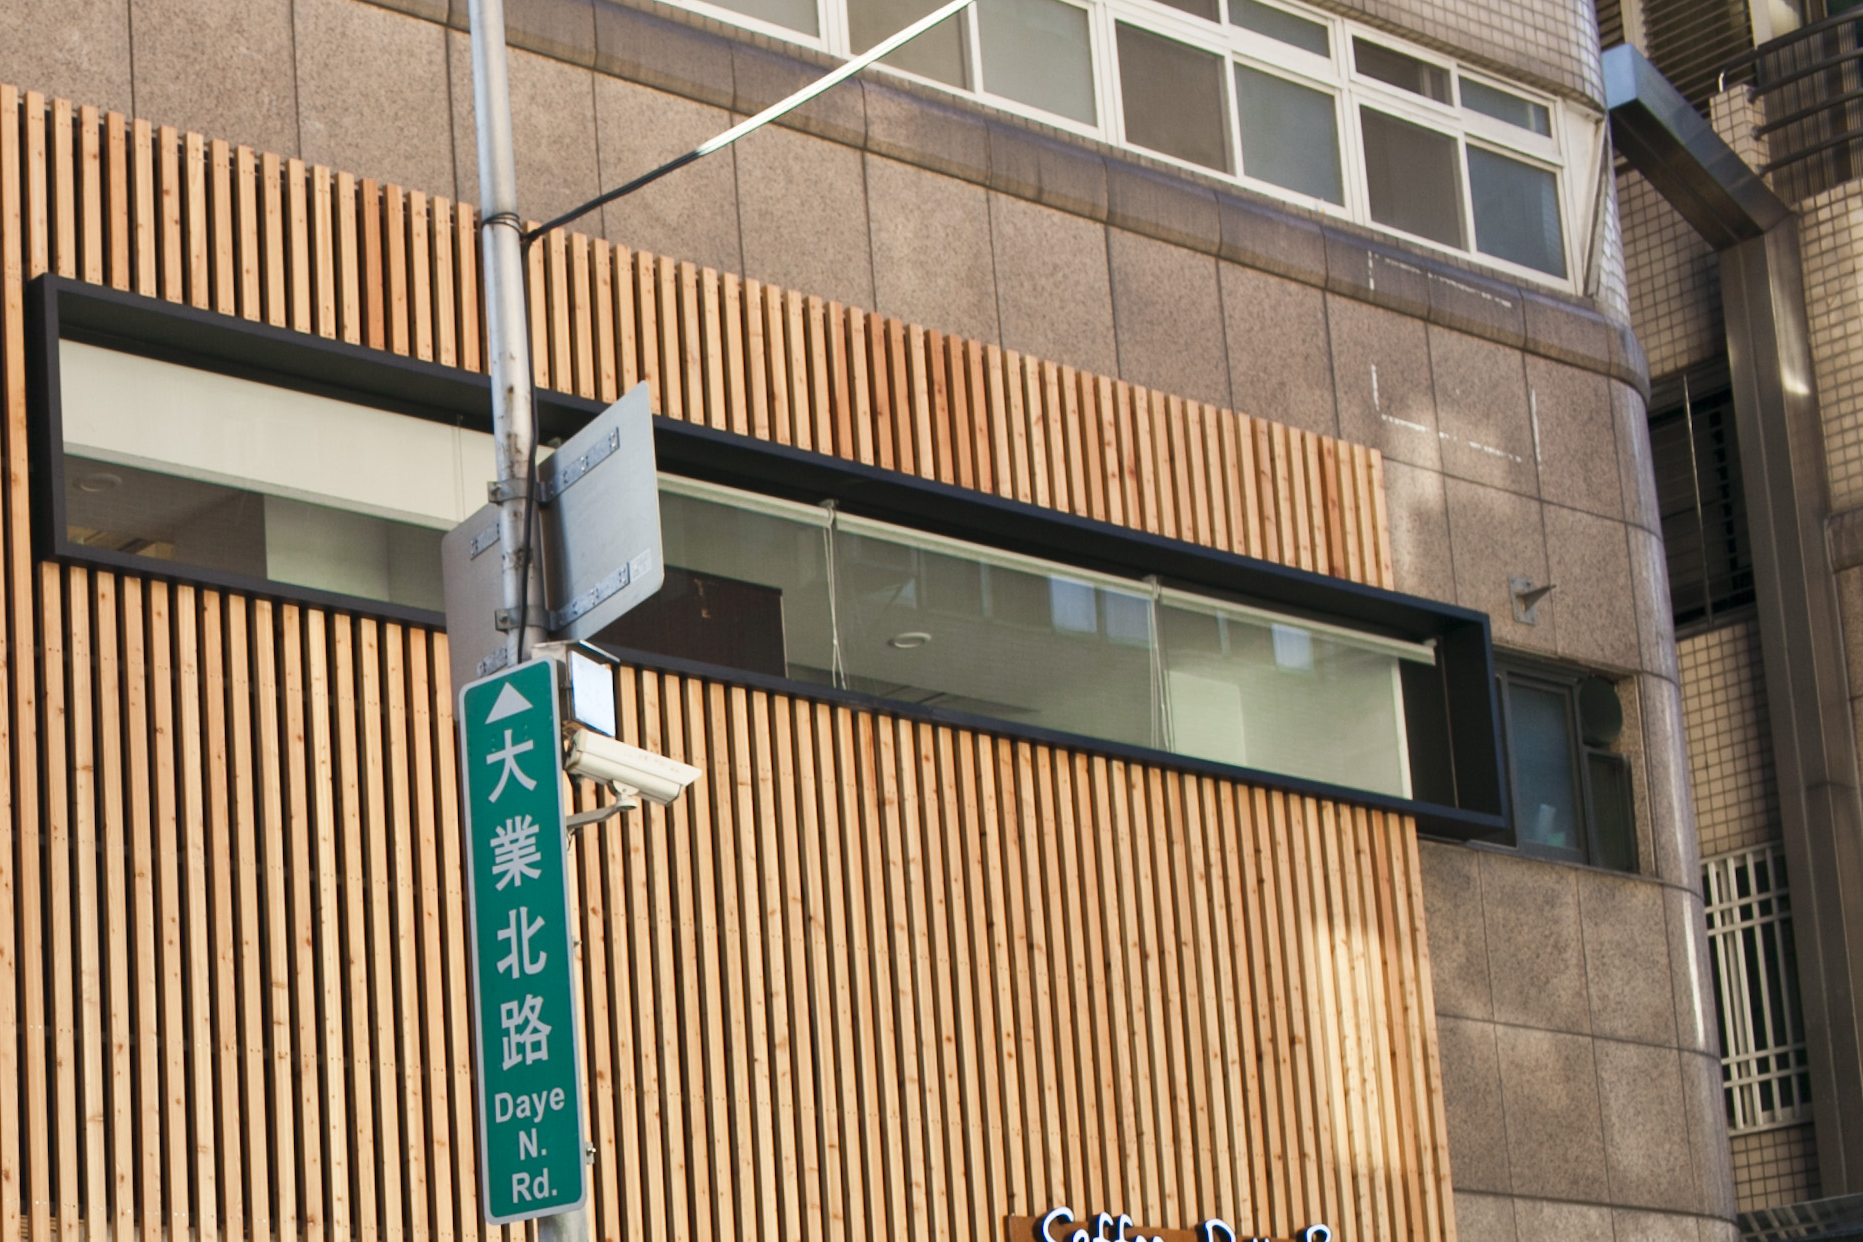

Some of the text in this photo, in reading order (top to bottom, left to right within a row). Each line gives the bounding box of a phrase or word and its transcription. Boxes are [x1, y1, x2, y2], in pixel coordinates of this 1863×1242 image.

[486, 729, 552, 1070] 大業北路
[494, 1086, 566, 1128] Daye
[518, 1128, 547, 1161] N.
[512, 1171, 558, 1204] Rd.
